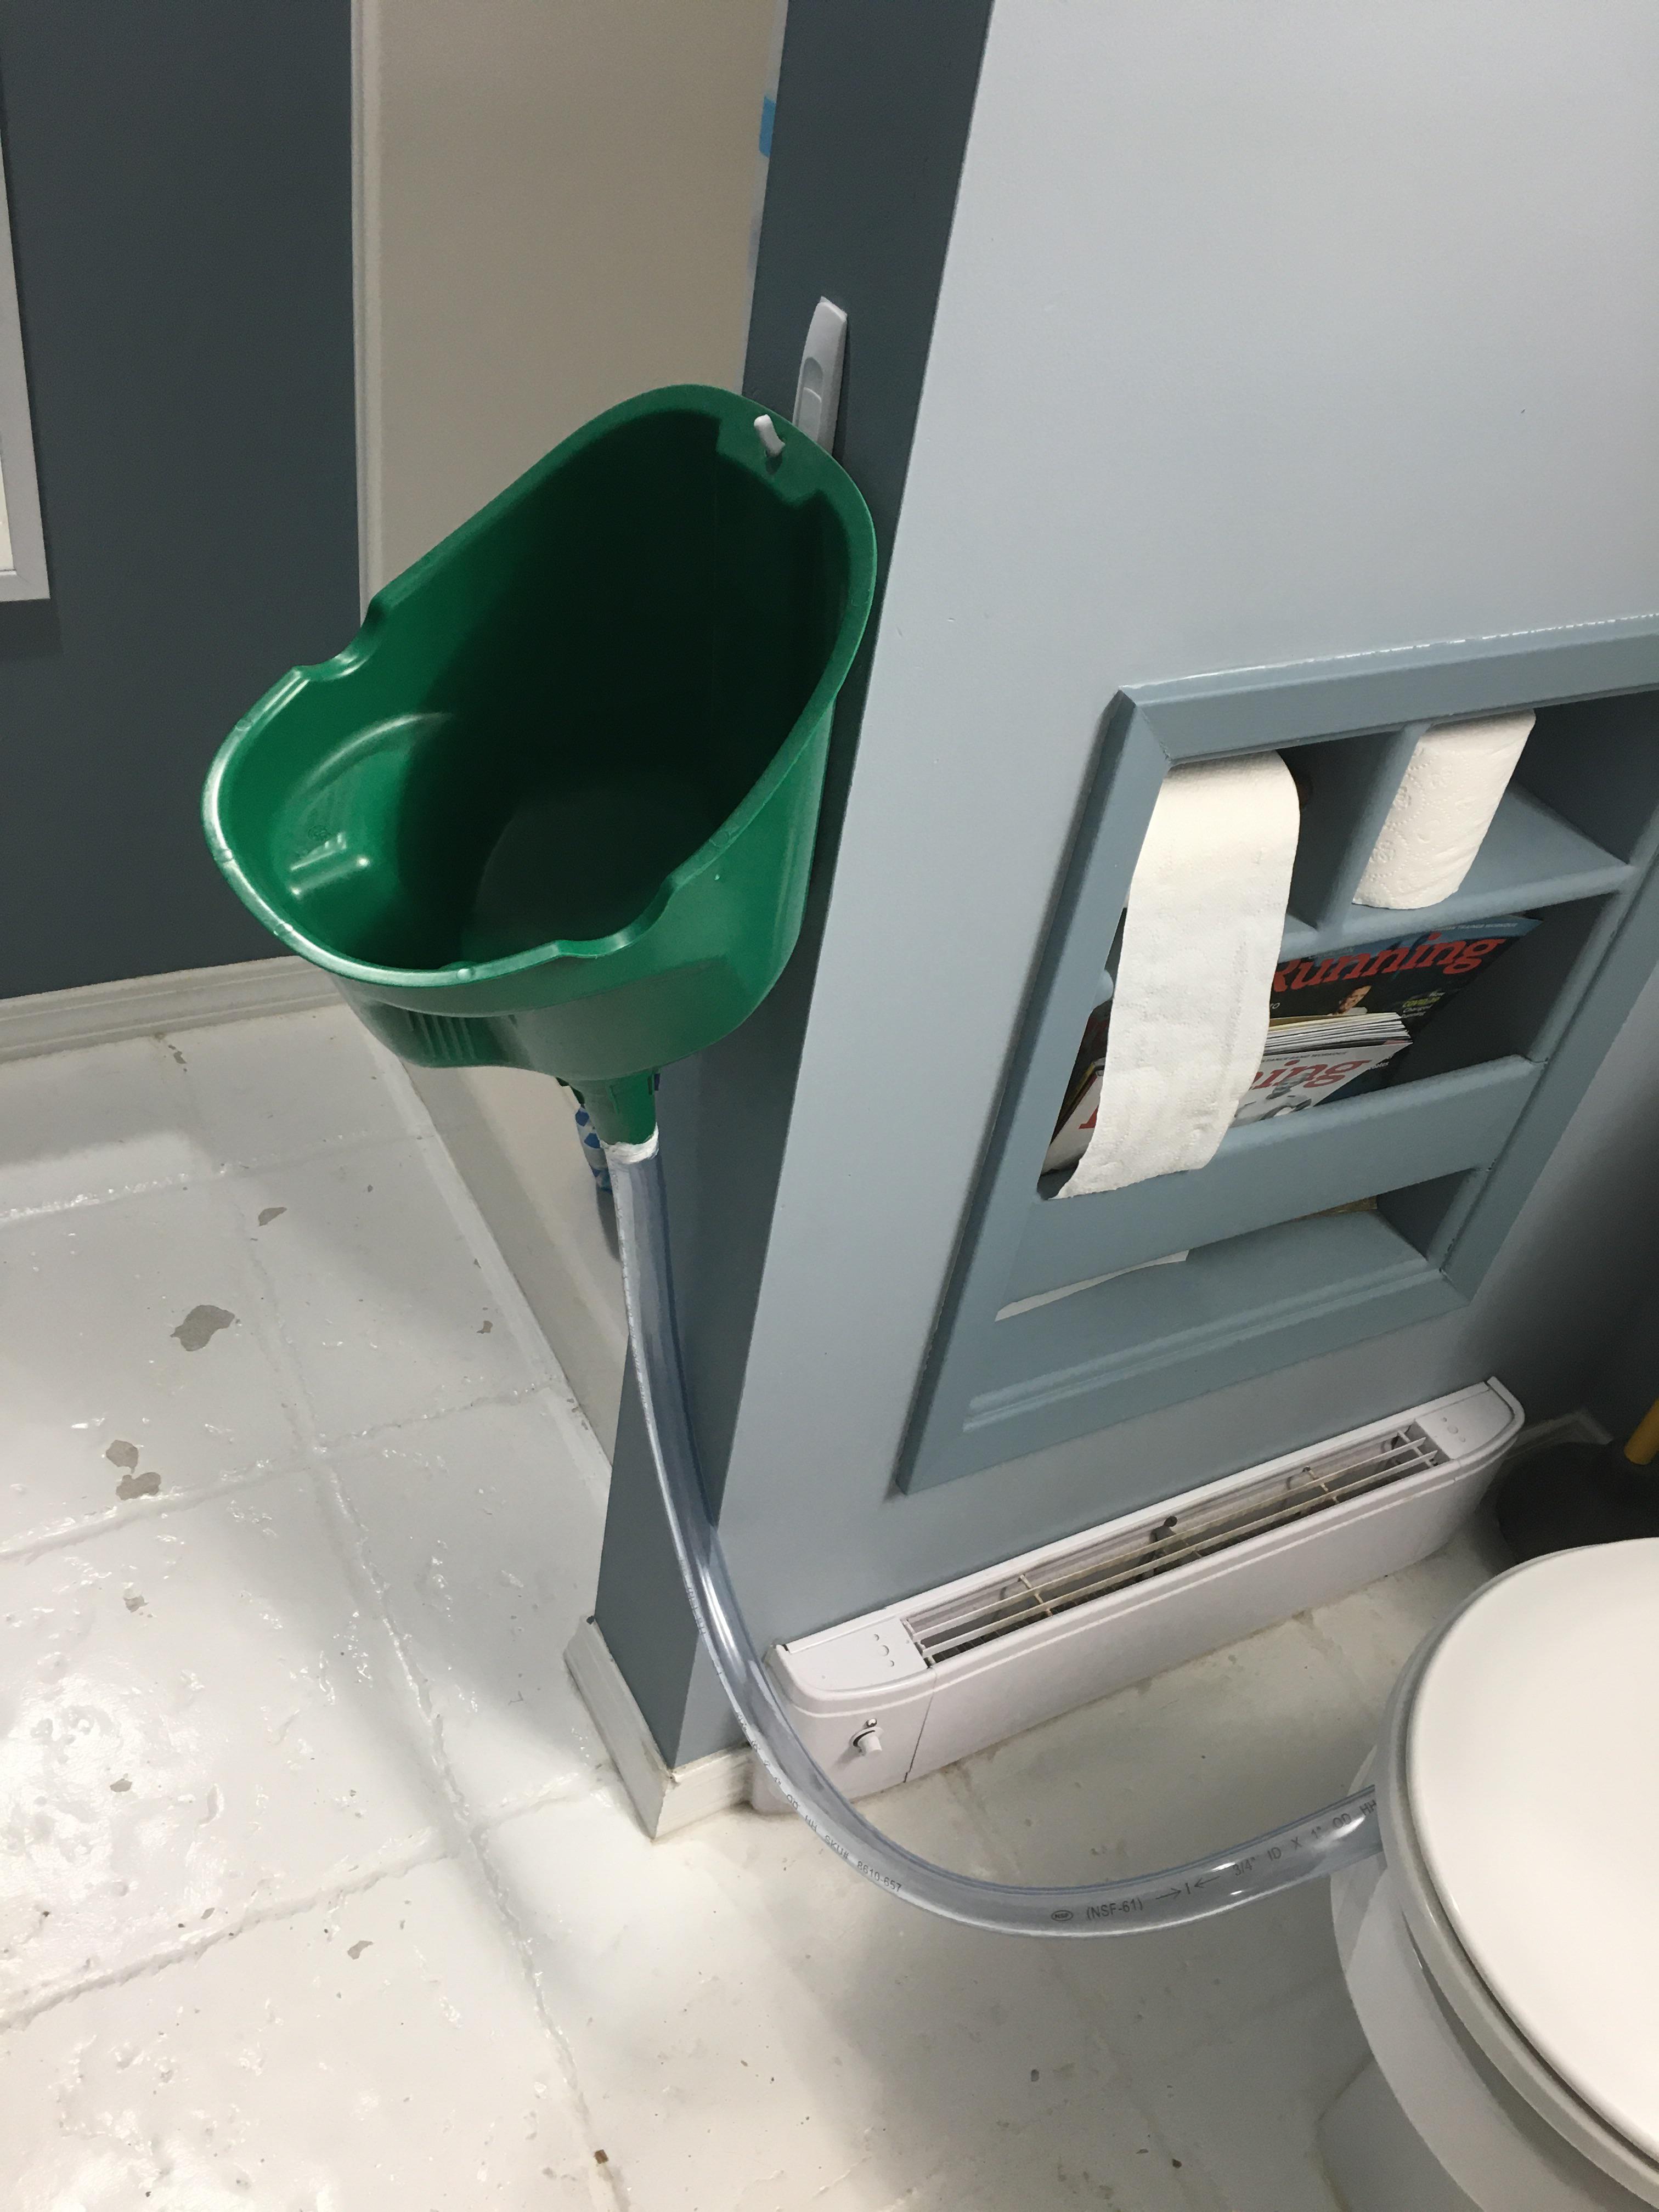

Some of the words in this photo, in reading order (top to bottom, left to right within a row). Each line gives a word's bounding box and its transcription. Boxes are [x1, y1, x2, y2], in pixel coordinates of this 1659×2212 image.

[824, 1835, 850, 1860] SKU#
[856, 1860, 902, 1893] 8610-657
[1086, 1897, 1143, 1921] (NSF-61)
[1267, 1847, 1282, 1861] ID
[1290, 1837, 1302, 1850] X
[1331, 1813, 1351, 1828] OD
